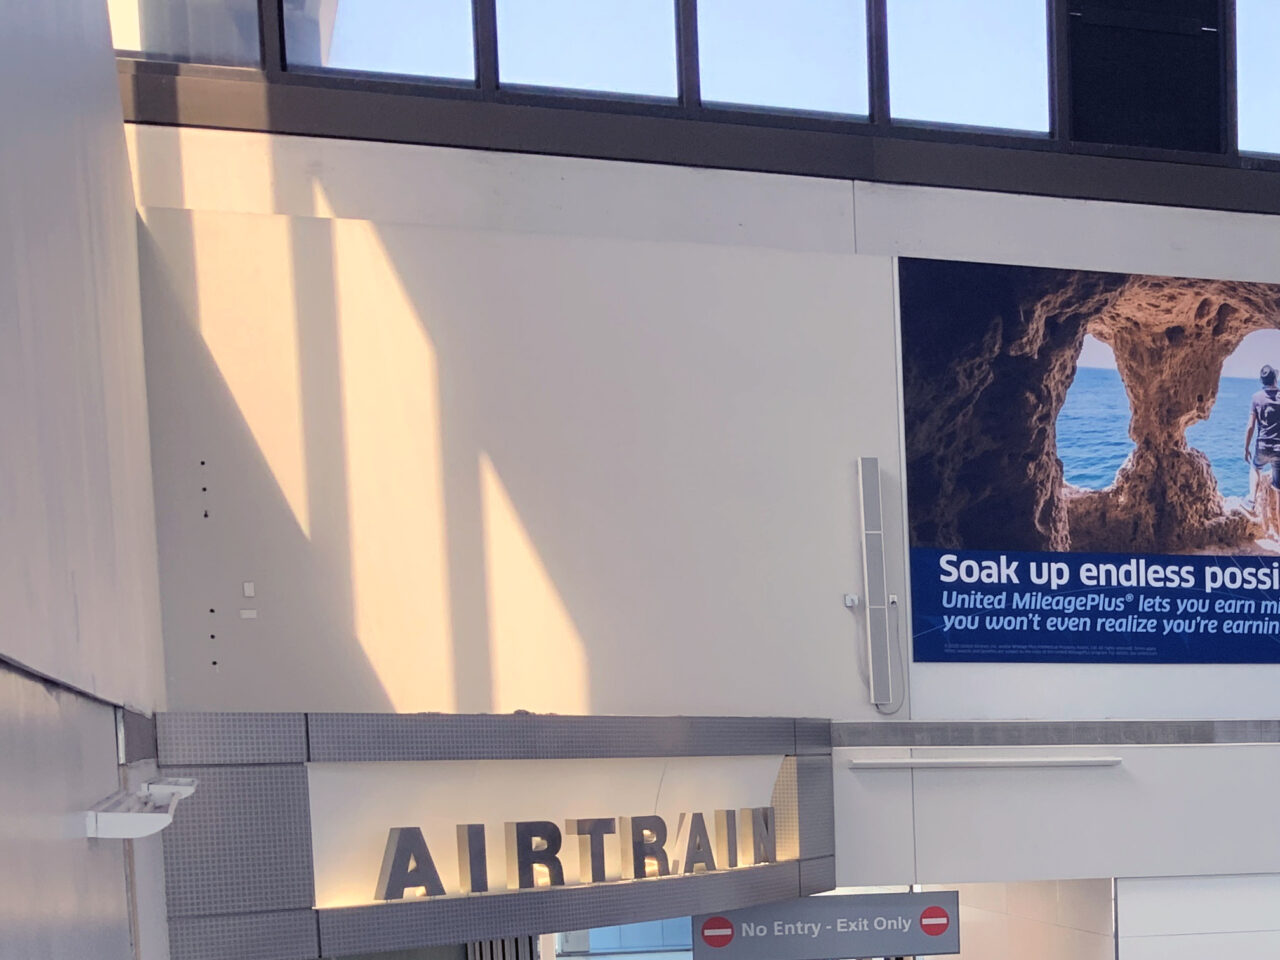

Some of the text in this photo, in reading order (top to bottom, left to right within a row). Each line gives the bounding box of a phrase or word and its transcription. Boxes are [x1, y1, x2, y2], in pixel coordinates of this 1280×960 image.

[939, 554, 1020, 584] Soak
[1029, 561, 1070, 590] up
[1079, 558, 1195, 588] endless
[942, 591, 1006, 609] United
[1138, 595, 1171, 612] lets
[1177, 599, 1210, 615] you
[1215, 600, 1255, 614] earn
[943, 615, 979, 632] you
[986, 613, 1041, 631] won't
[1046, 616, 1091, 632] even
[1096, 616, 1157, 633] realize
[1163, 617, 1218, 635] you're
[375, 806, 778, 901] AIRTRAIN
[741, 922, 768, 937] No
[774, 921, 822, 938] Entry
[837, 918, 870, 933] Exit
[873, 916, 912, 933] Only
